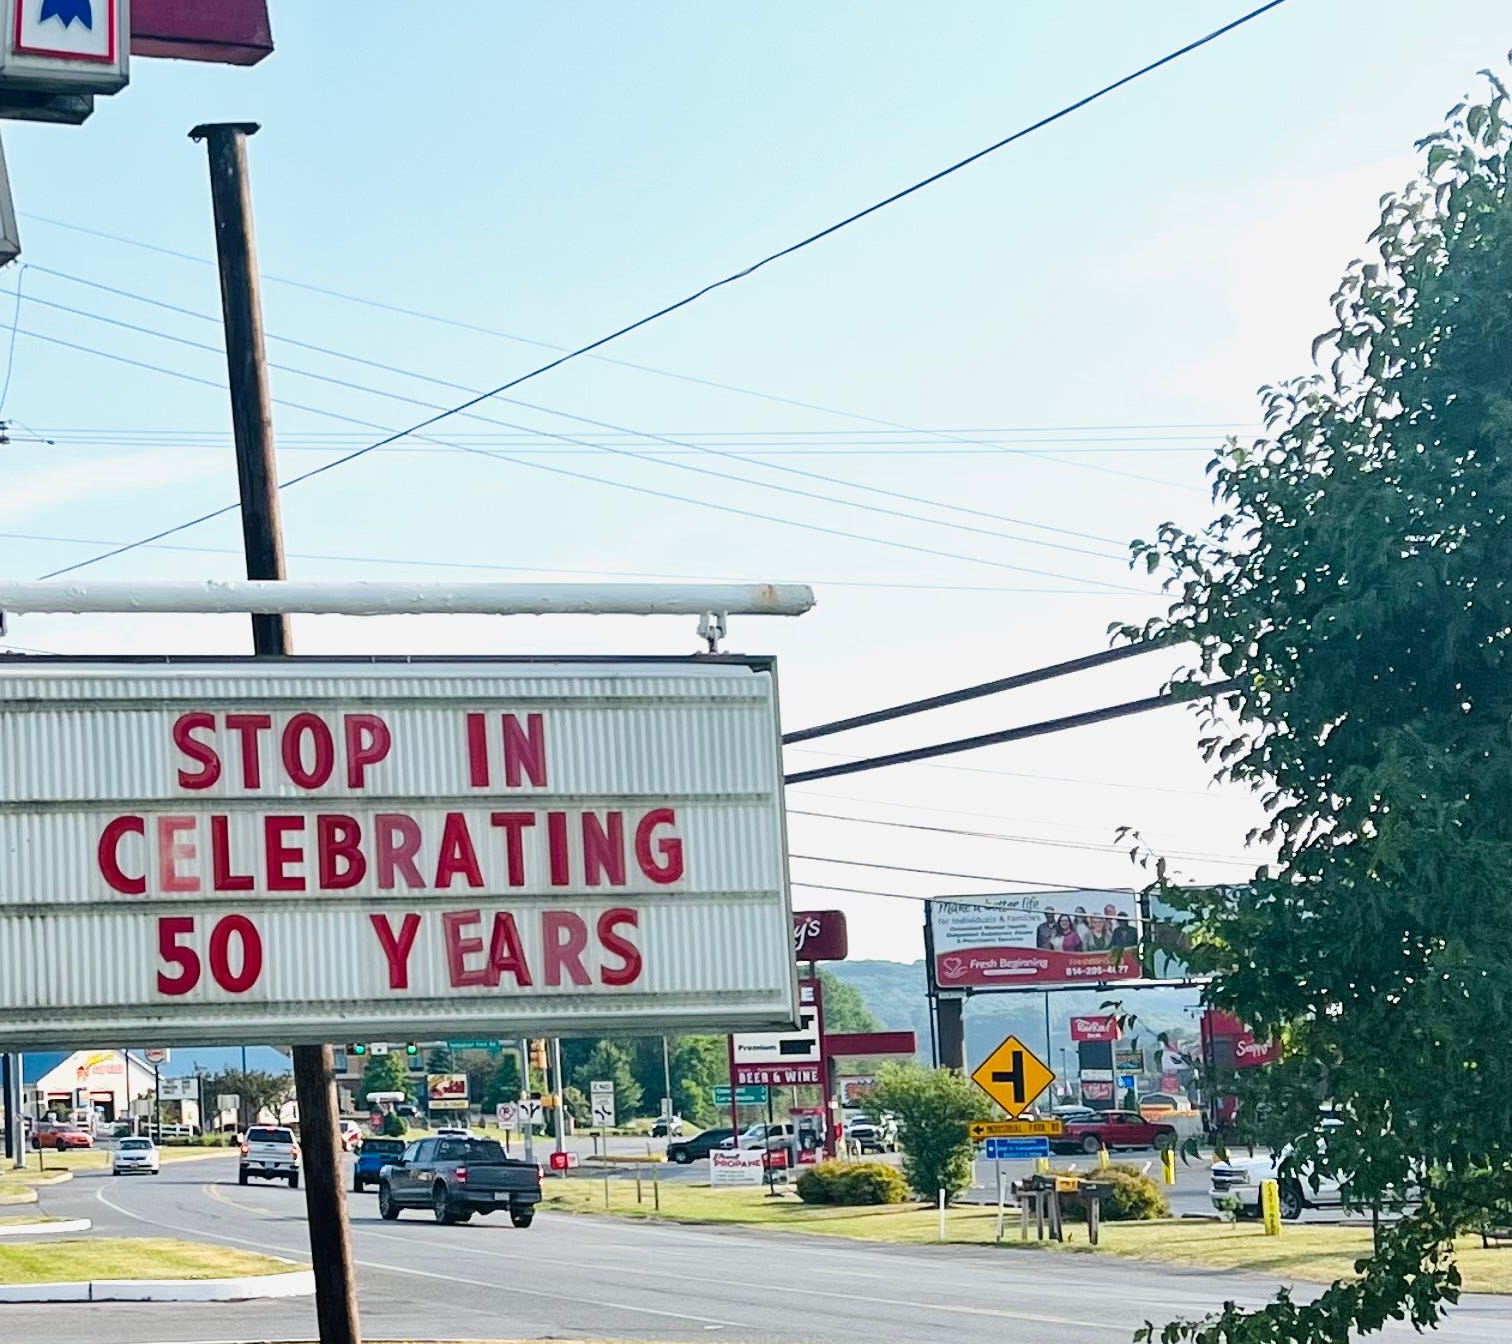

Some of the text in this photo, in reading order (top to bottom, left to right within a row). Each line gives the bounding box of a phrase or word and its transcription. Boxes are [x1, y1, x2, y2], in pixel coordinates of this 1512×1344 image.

[173, 712, 548, 789] STOP IN
[98, 808, 683, 894] CELEBRATING
[157, 907, 642, 995] 50 YEARS
[970, 958, 1049, 969] Fresh Beginning
[739, 1070, 819, 1084] BEER & WINE
[715, 1159, 761, 1168] PROPANE
